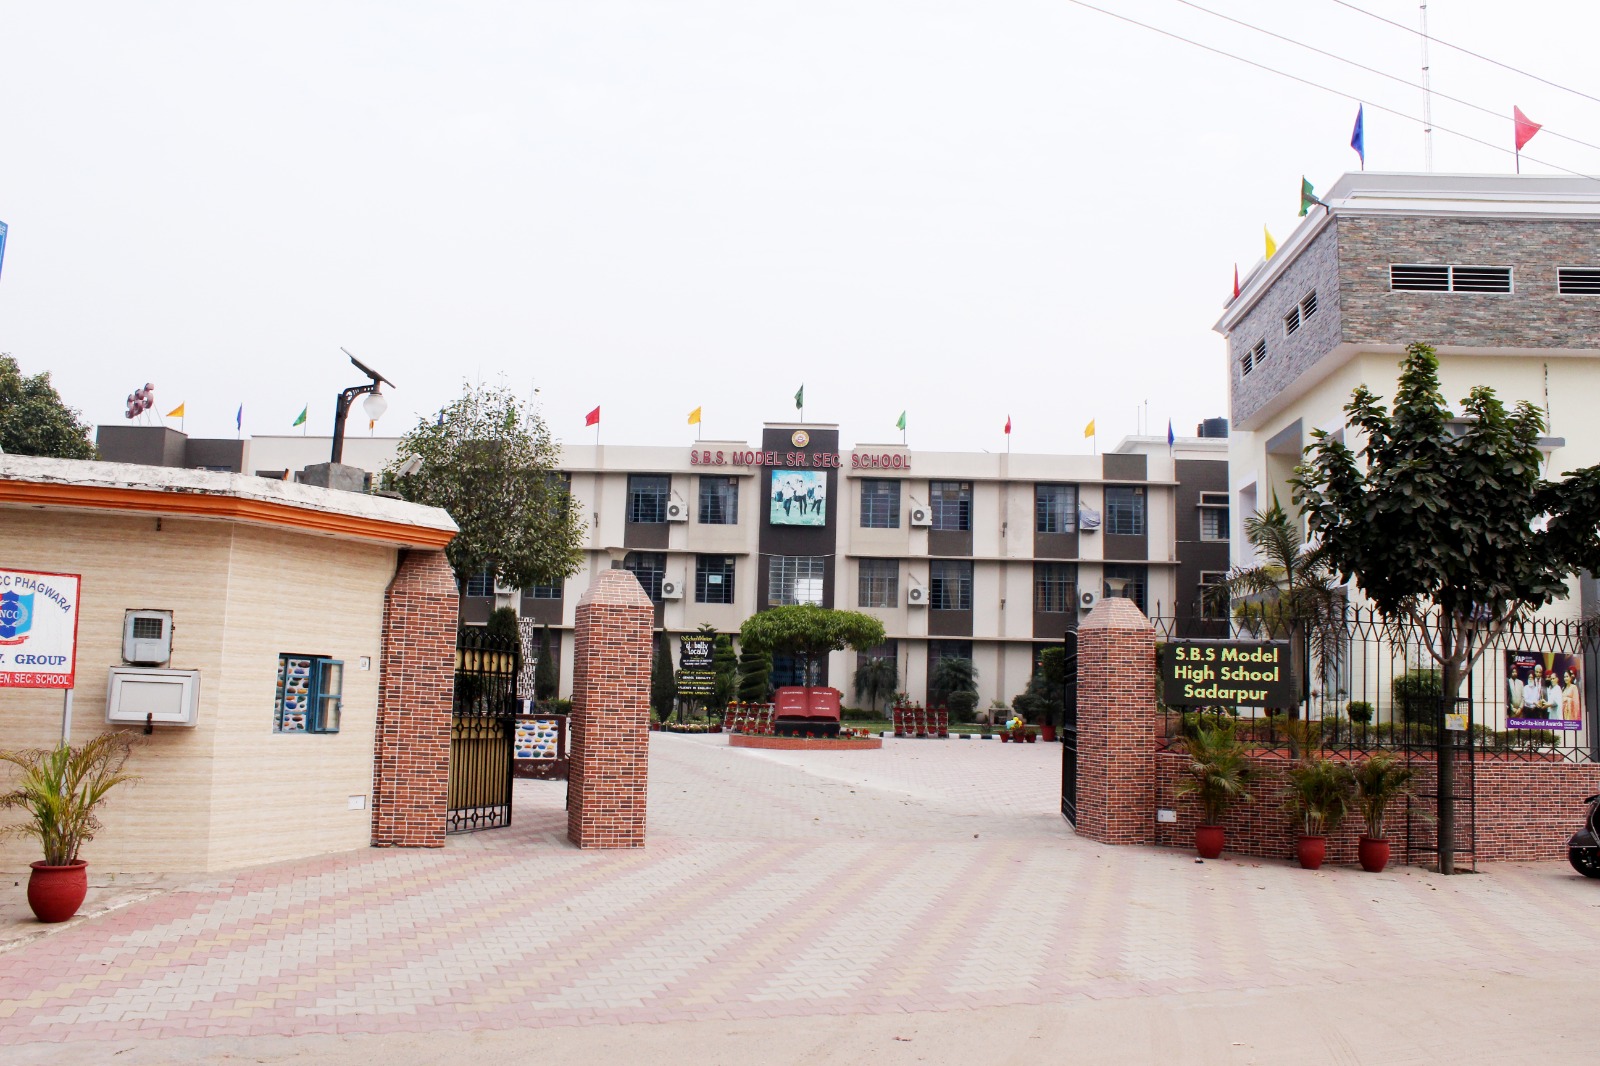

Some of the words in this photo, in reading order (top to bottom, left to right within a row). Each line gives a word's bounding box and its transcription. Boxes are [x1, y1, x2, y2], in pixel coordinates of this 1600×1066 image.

[732, 450, 782, 466] MODEL
[786, 452, 809, 467] SR.
[812, 452, 844, 468] SEC.
[851, 453, 911, 469] SCHOOL
[15, 576, 72, 613] PHAGWARA
[15, 654, 66, 665] GROUP
[1175, 647, 1216, 661] S.B.S
[1221, 647, 1278, 663] Model
[14, 673, 34, 684] SEC.
[35, 674, 70, 685] SCHOOL
[1174, 664, 1215, 683] High
[1220, 665, 1279, 682] School
[1184, 683, 1268, 704] Sadarpur
